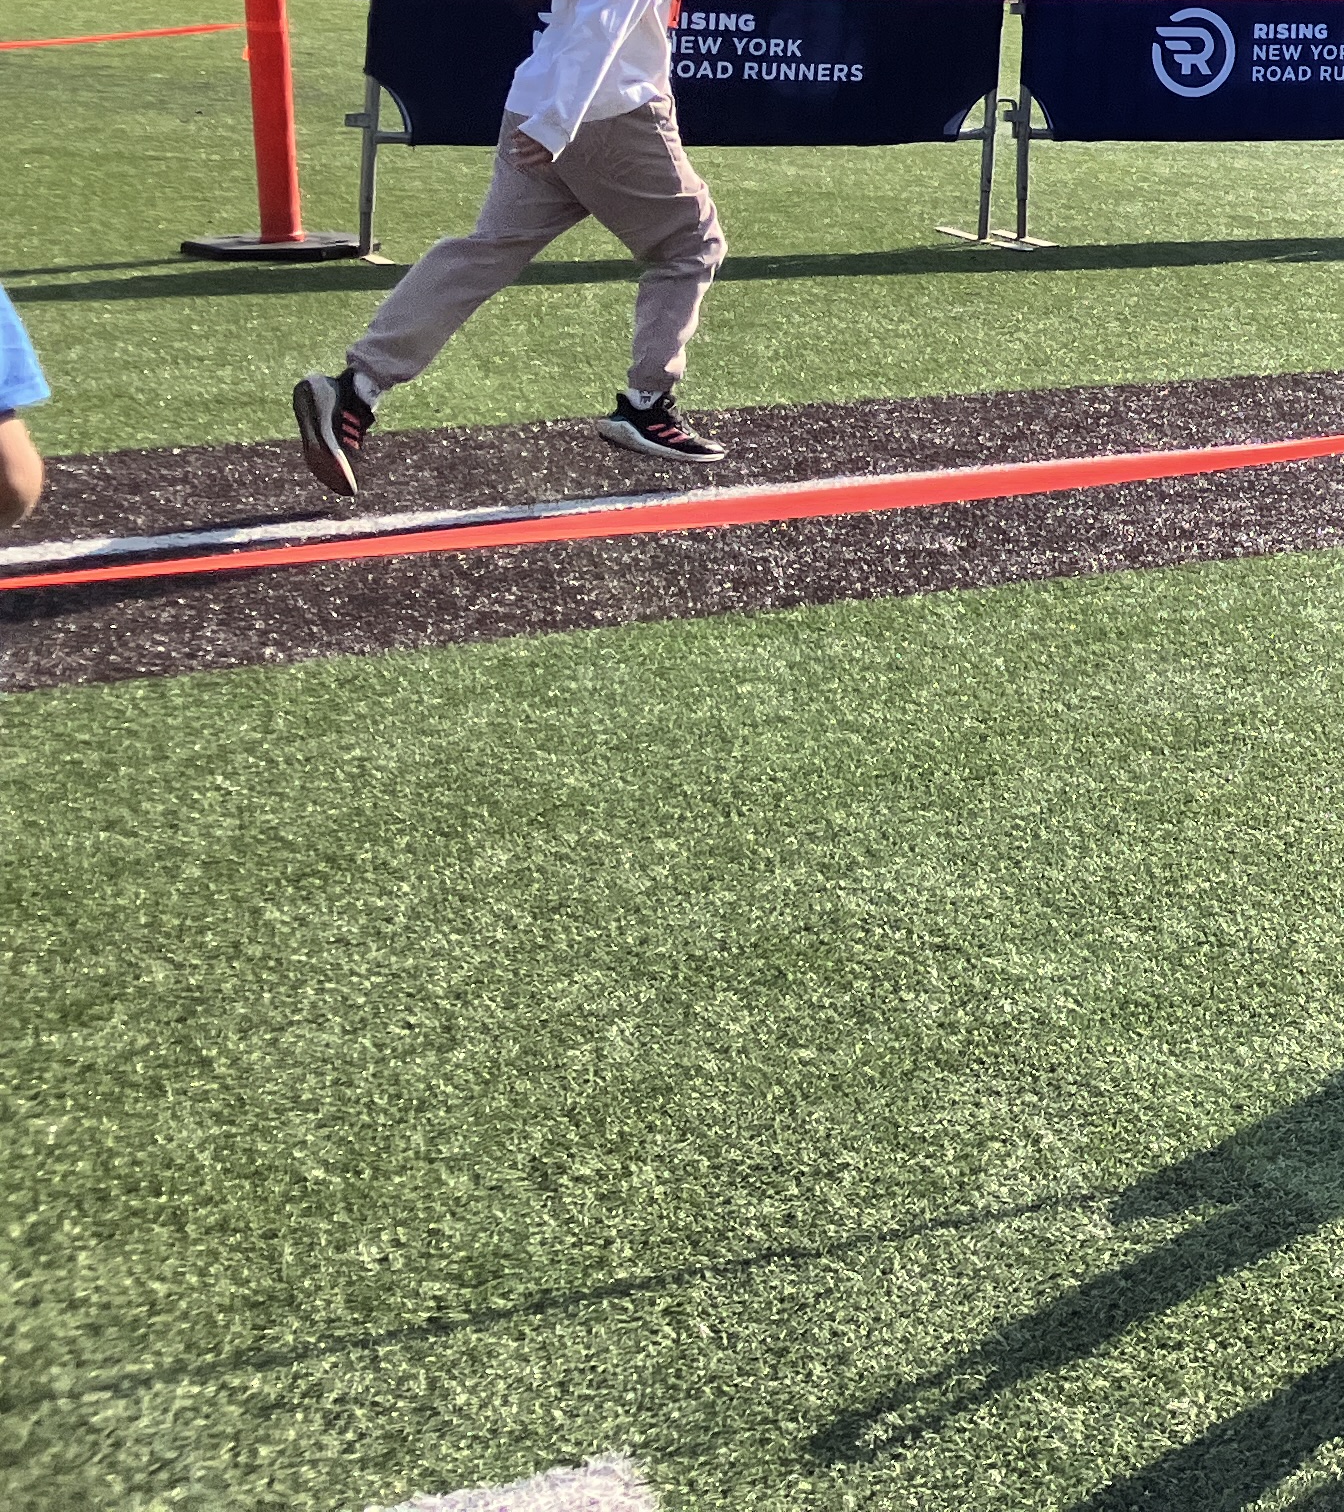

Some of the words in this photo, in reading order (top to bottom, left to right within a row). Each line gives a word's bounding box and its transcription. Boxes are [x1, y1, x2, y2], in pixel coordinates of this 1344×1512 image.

[676, 12, 756, 32] ISING
[1253, 23, 1328, 40] RISING
[733, 37, 803, 57] YORK
[1252, 44, 1303, 61] NEW
[669, 60, 733, 79] OAD
[743, 62, 864, 82] RUNNERS
[1251, 64, 1312, 82] ROAD
